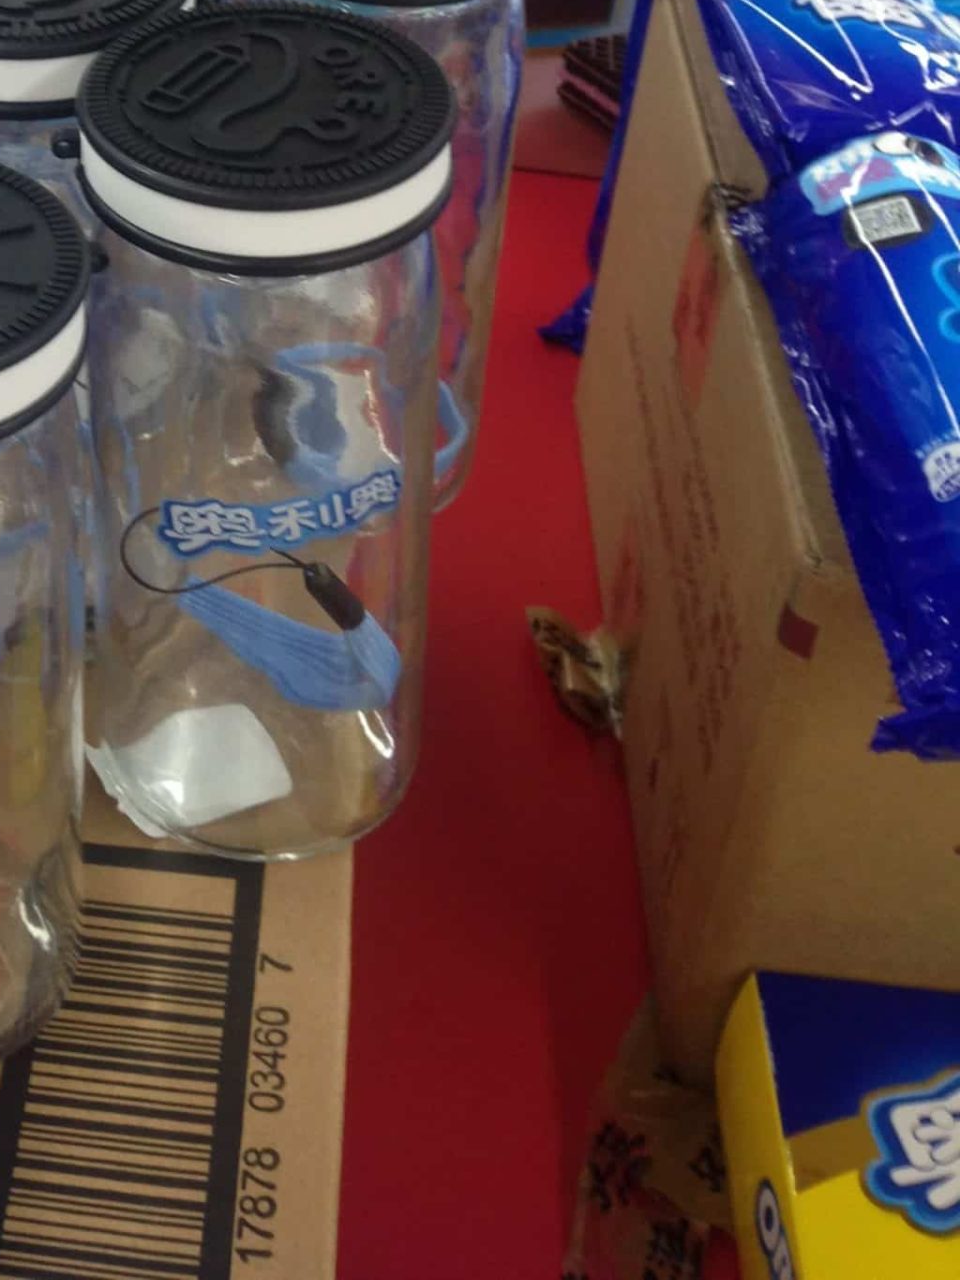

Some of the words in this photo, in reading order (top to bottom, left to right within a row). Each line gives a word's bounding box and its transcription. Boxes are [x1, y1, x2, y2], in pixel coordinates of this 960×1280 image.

[167, 474, 399, 550] 奥利奥
[259, 953, 293, 974] 7
[248, 1006, 291, 1113] 03460
[236, 1147, 280, 1263] 17878
